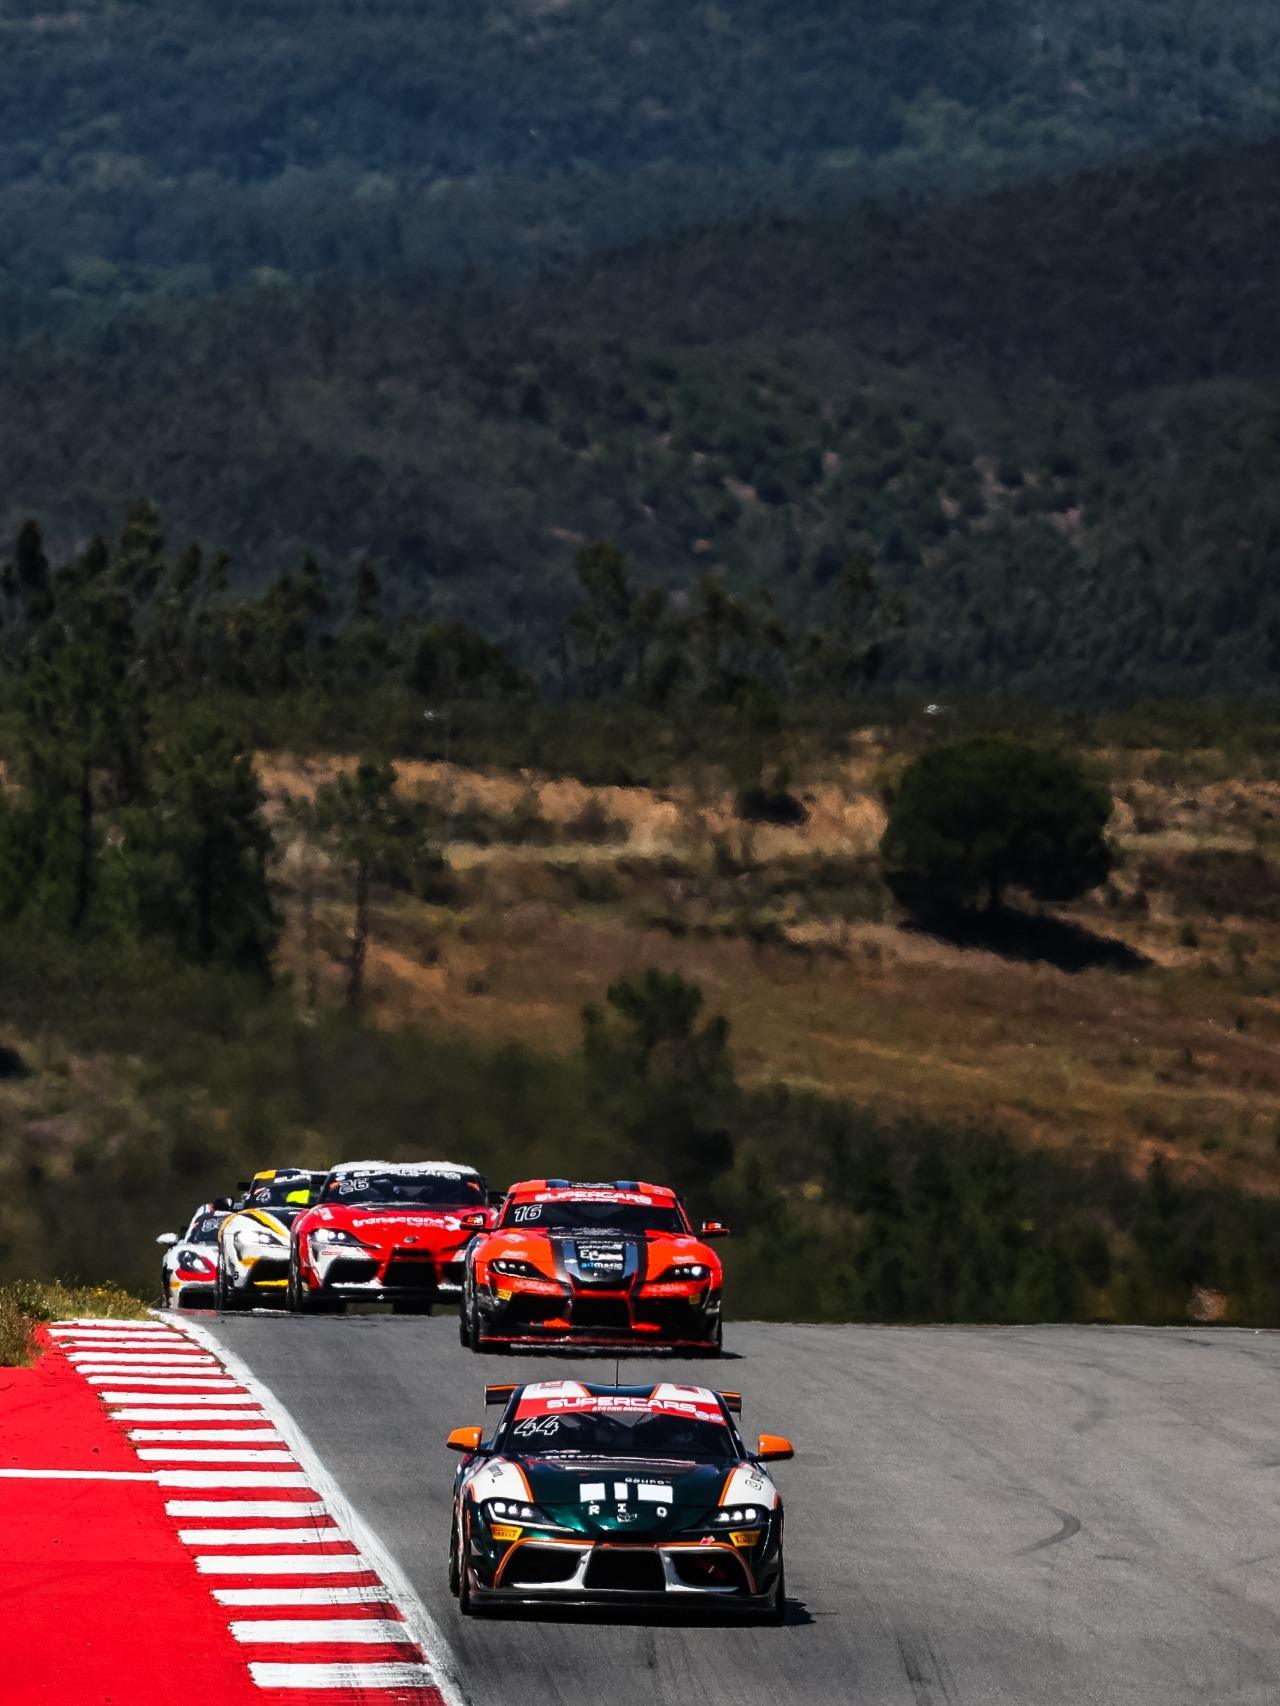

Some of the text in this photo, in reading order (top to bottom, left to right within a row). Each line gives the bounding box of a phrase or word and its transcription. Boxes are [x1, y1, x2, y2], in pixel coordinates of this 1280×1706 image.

[338, 1177, 369, 1195] 26
[534, 1190, 652, 1205] SUPERCARS
[514, 1204, 543, 1223] 16
[546, 1396, 697, 1413] SUPERCARS
[513, 1415, 560, 1437] 44
